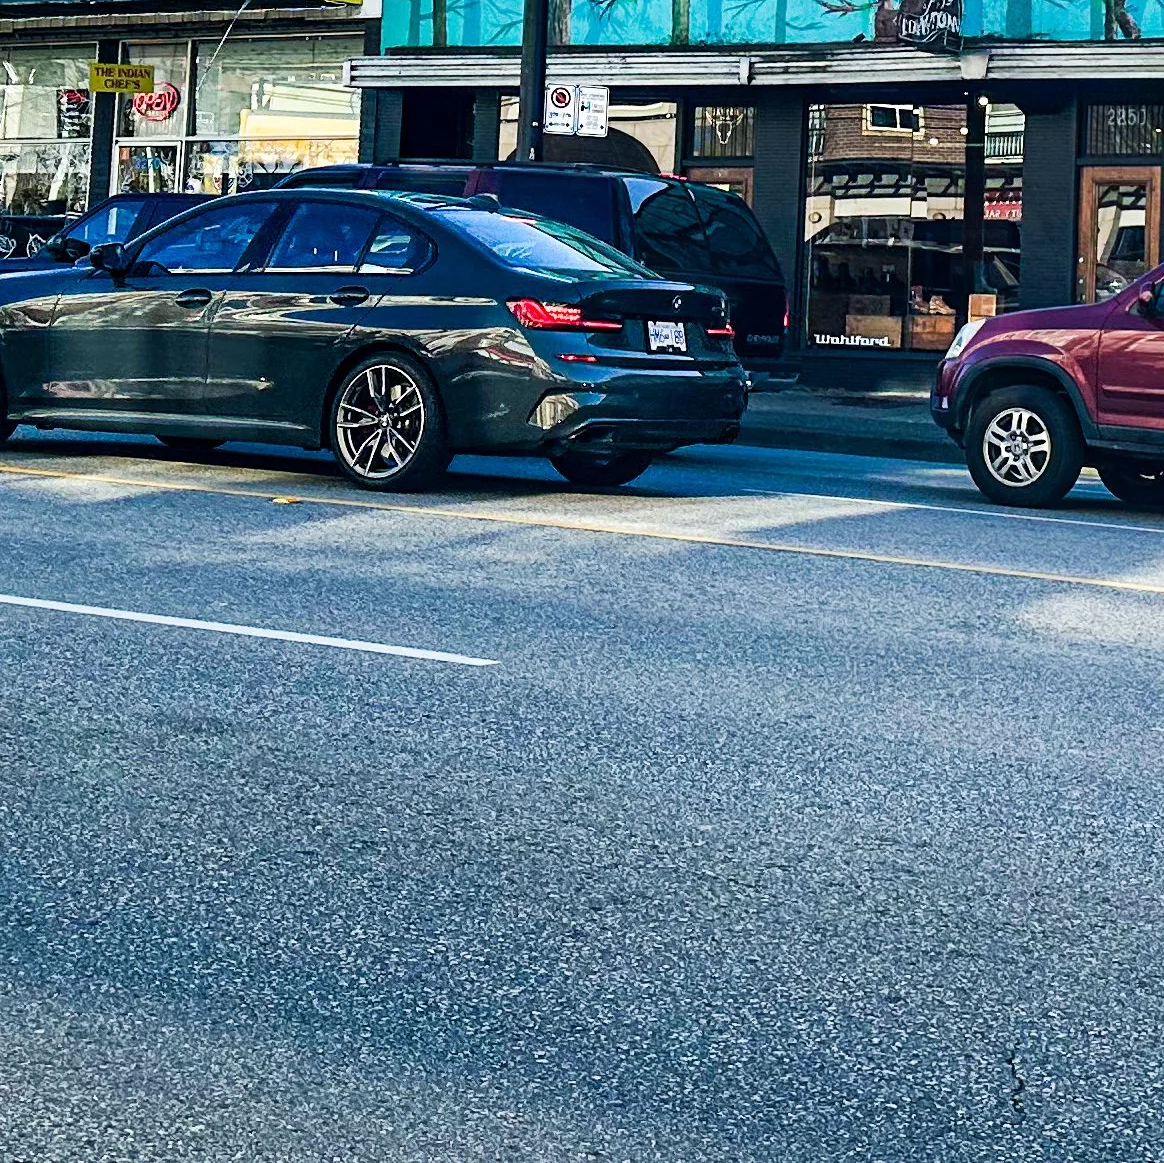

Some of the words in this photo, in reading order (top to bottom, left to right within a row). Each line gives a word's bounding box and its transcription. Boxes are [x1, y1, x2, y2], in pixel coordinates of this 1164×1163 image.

[94, 66, 116, 77] THE
[117, 67, 151, 79] INDIAN
[136, 90, 173, 112] OPEN
